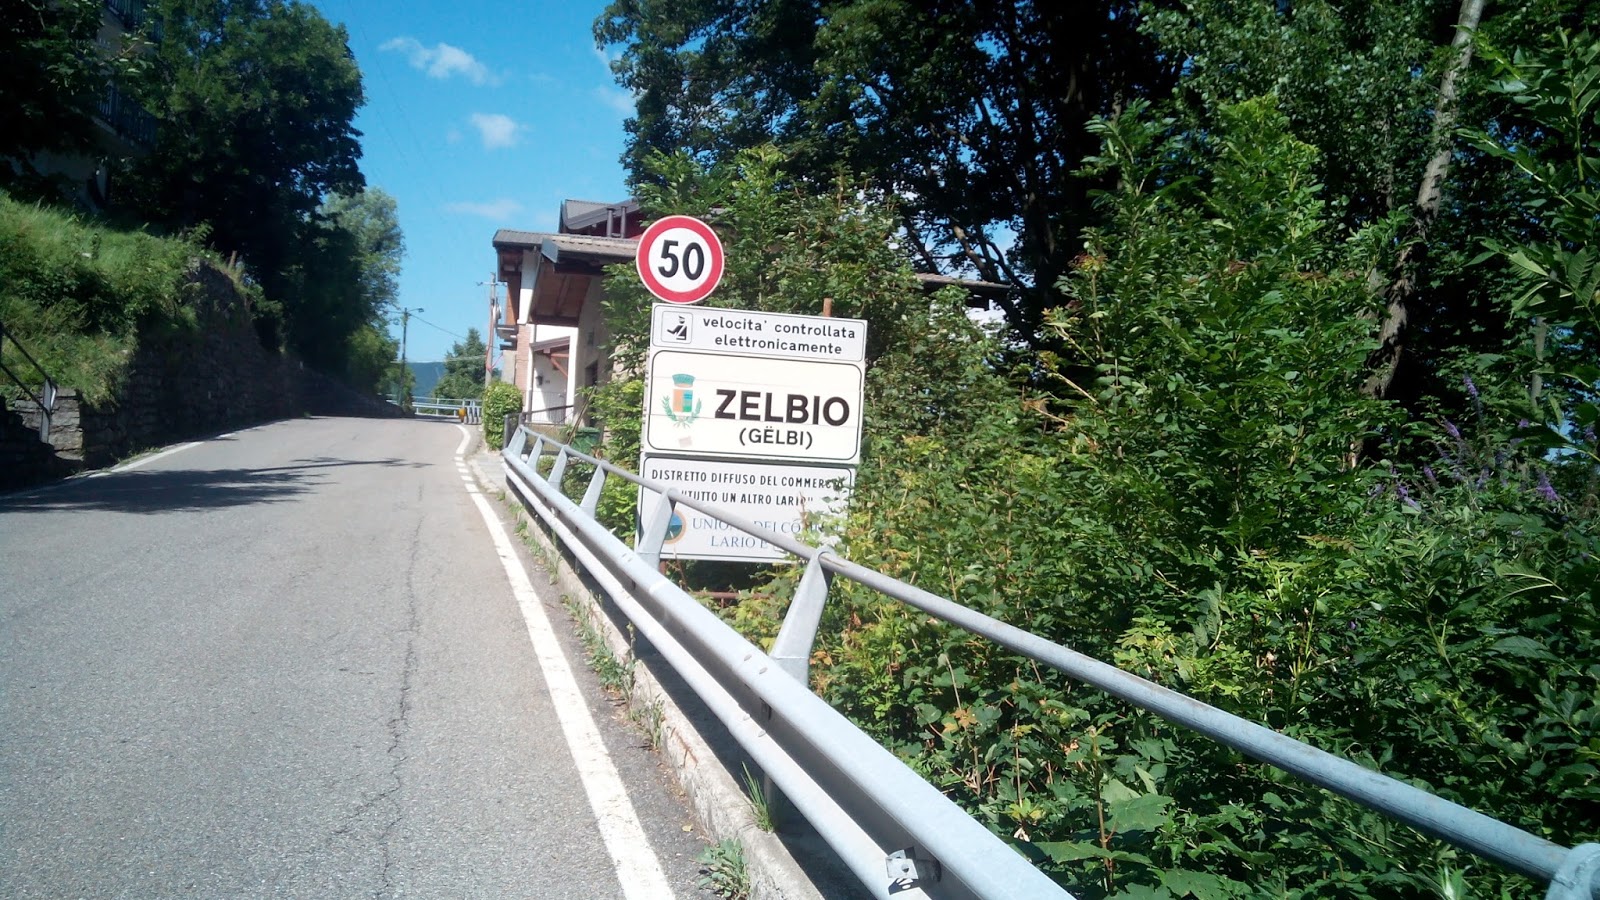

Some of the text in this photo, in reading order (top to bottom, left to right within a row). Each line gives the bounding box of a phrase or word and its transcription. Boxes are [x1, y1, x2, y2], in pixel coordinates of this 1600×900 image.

[657, 239, 705, 281] 50
[774, 324, 856, 339] controllata
[714, 335, 843, 355] elettronicamente
[714, 388, 850, 427] ZELBIO
[738, 425, 813, 450] (GËLBI)
[651, 469, 844, 491] DISTRETTO DIFFUSO DEL COMMERC
[722, 492, 737, 503] UN
[740, 493, 772, 505] ALTRO
[711, 535, 756, 548] LARIO
